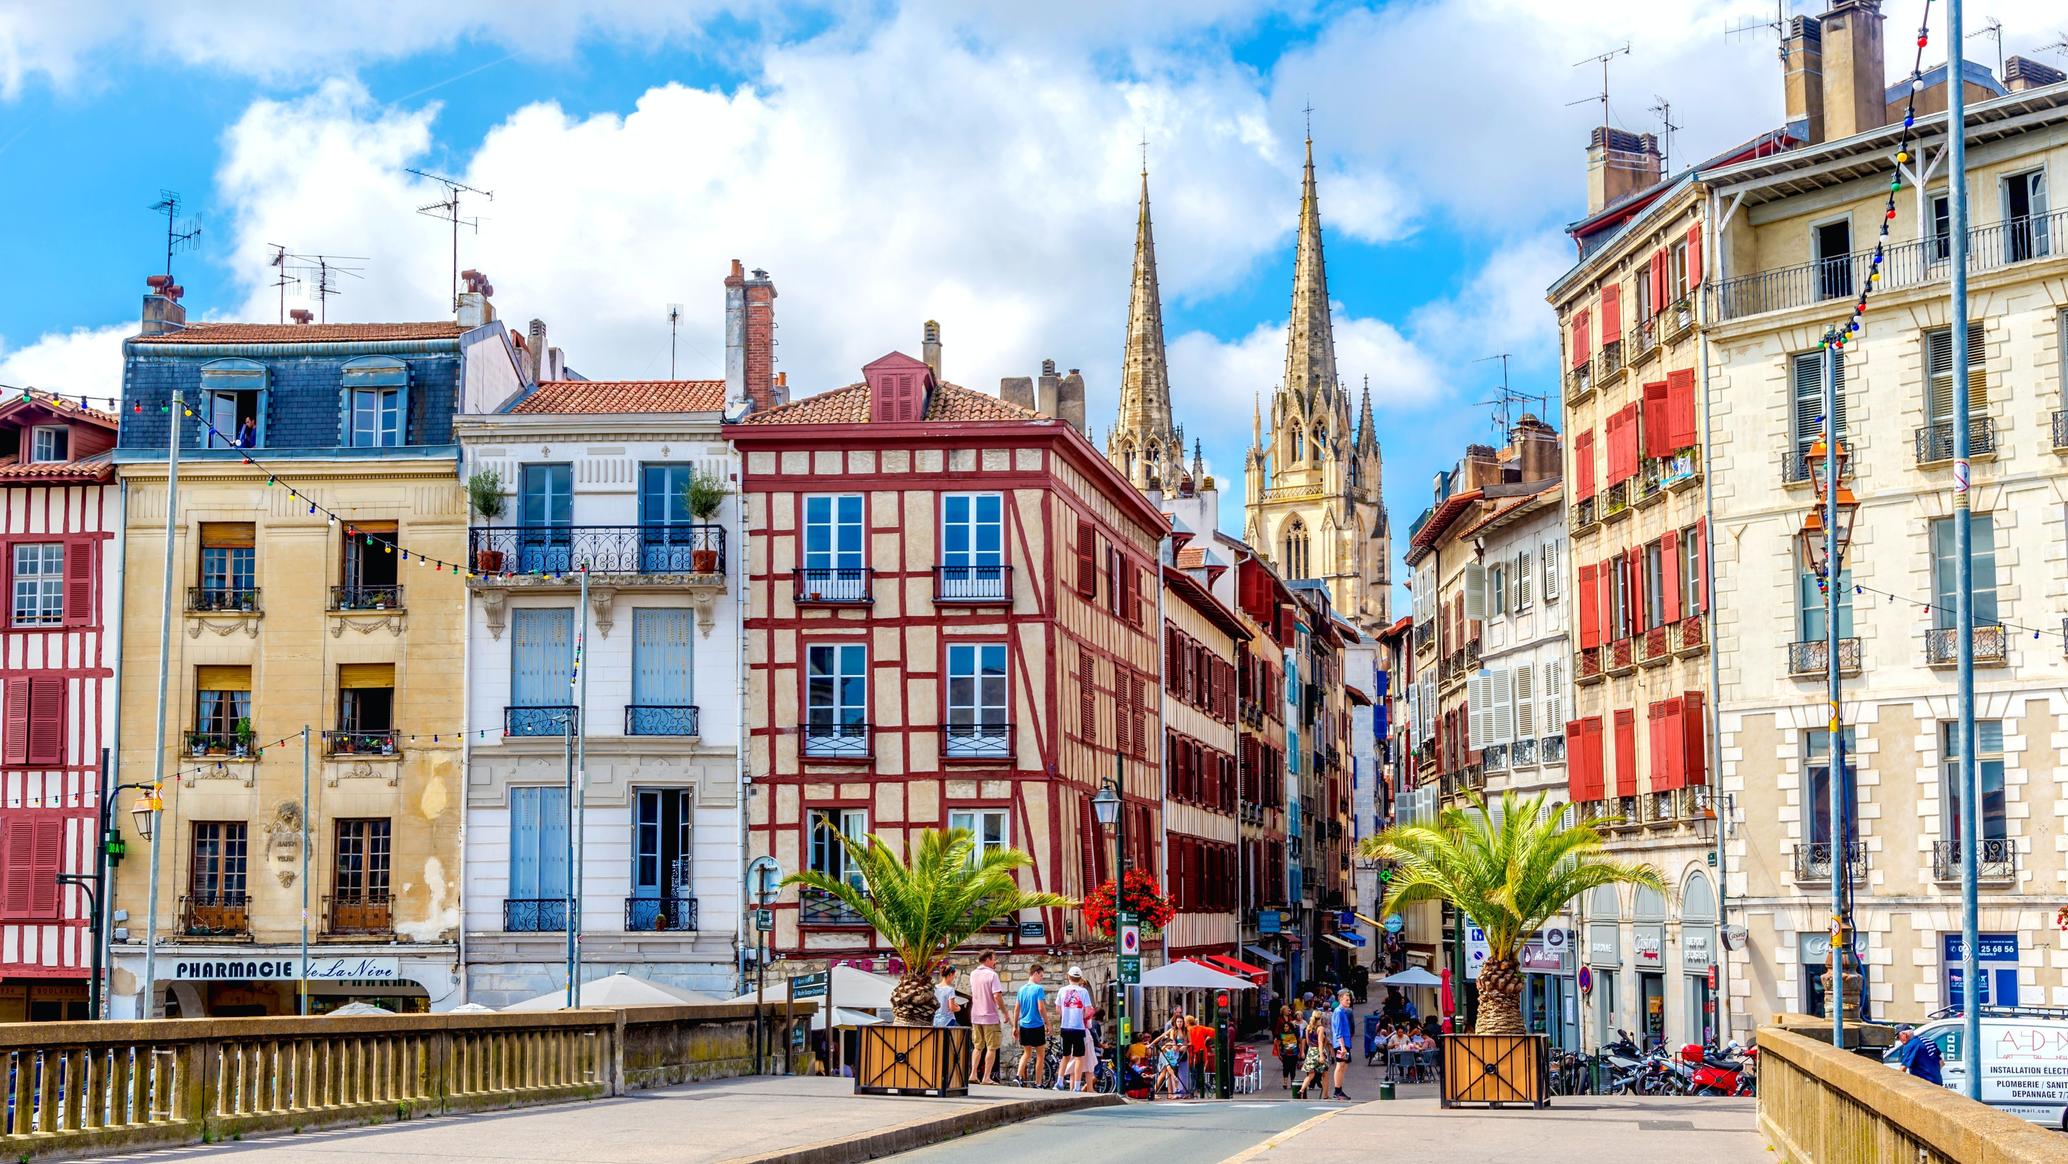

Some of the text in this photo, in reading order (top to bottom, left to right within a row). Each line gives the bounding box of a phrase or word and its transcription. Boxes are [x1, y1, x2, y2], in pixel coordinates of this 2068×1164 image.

[1728, 931, 1746, 941] Casino
[1634, 934, 1659, 954] Casino
[176, 961, 292, 978] PHARMACIE
[320, 959, 345, 977] La
[348, 959, 392, 977] Nive
[1990, 1066, 2041, 1074] INSTALLATION
[1996, 1080, 2039, 1088] PLOMBERIE
[2046, 1081, 2068, 1089] SANIT
[2012, 1090, 2056, 1098] DEPANNAGE
